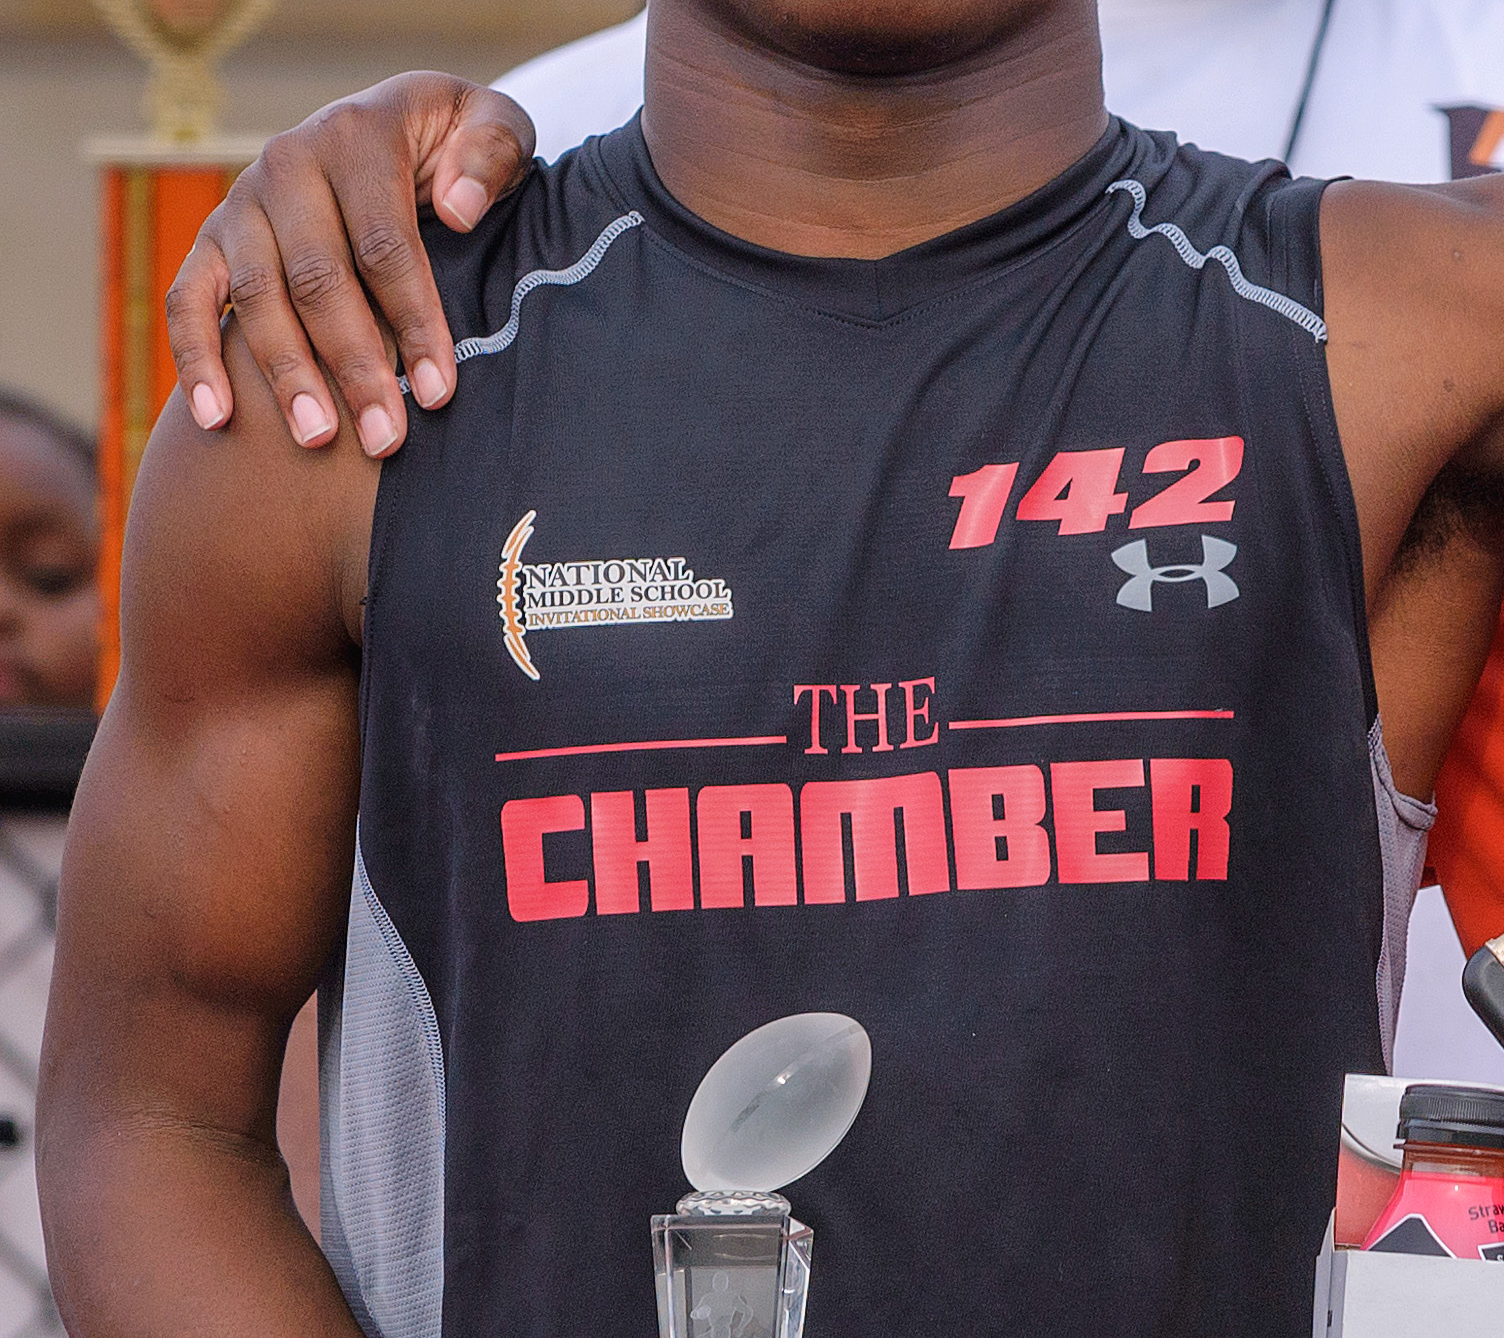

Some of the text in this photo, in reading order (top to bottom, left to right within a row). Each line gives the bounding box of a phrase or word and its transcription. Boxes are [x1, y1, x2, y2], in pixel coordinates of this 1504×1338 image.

[948, 435, 1245, 551] 142
[526, 560, 691, 589] NATIONAL
[527, 581, 730, 609] MIDDLE SCHOOL
[528, 603, 730, 627] INVITATIONAL SHOWCASE
[793, 677, 940, 755] THE
[501, 758, 1233, 923] CHAMBER
